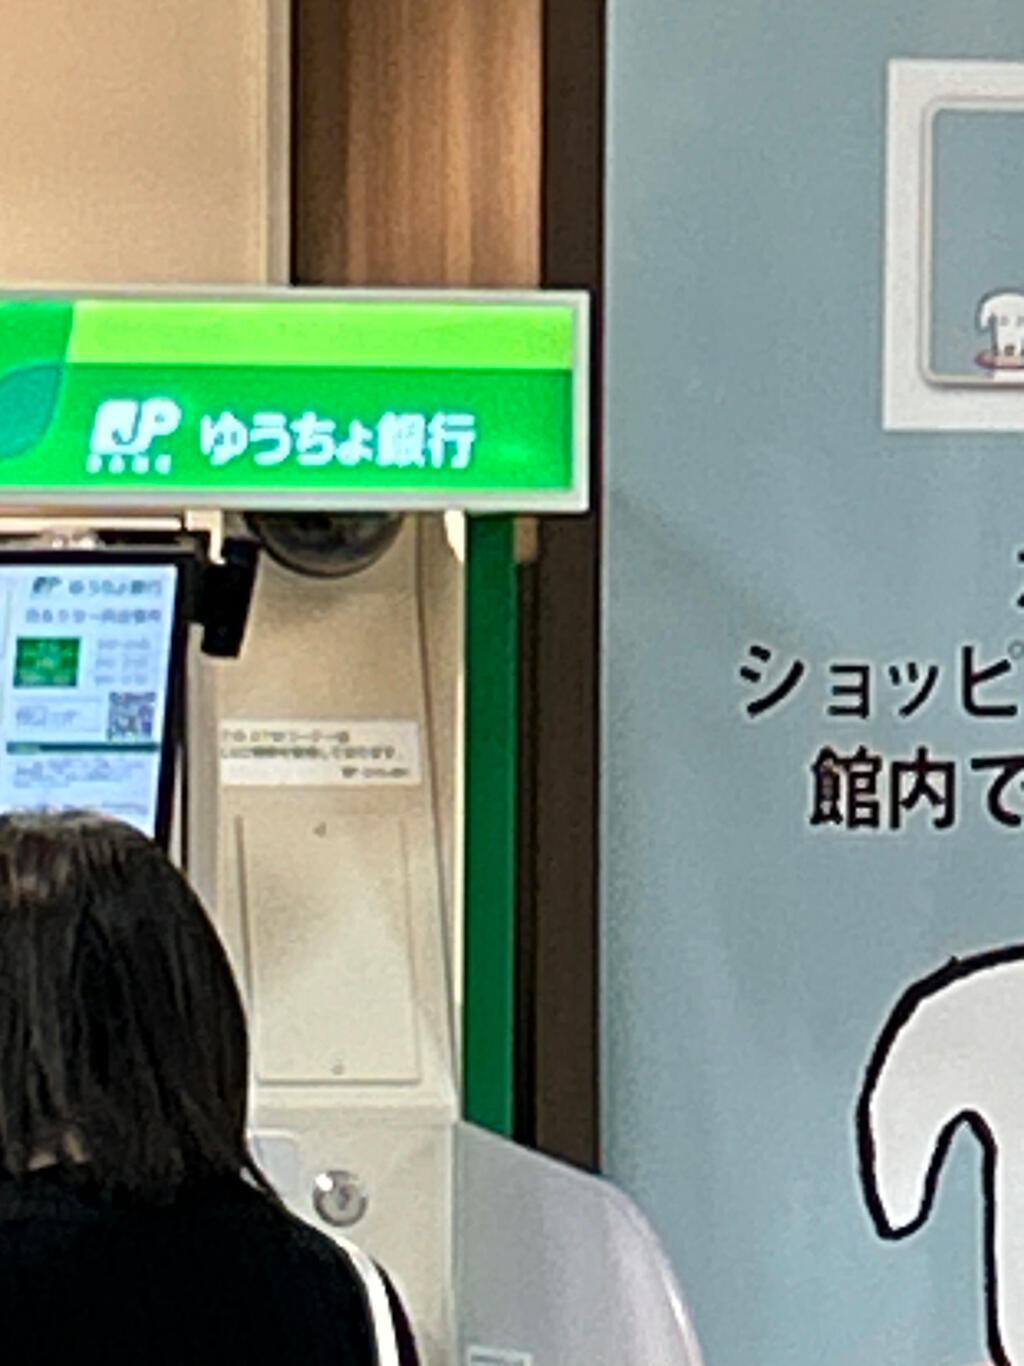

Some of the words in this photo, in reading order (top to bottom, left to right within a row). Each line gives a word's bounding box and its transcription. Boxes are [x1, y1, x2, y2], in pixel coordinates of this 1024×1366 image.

[200, 411, 475, 469] ゆうちょ銀行
